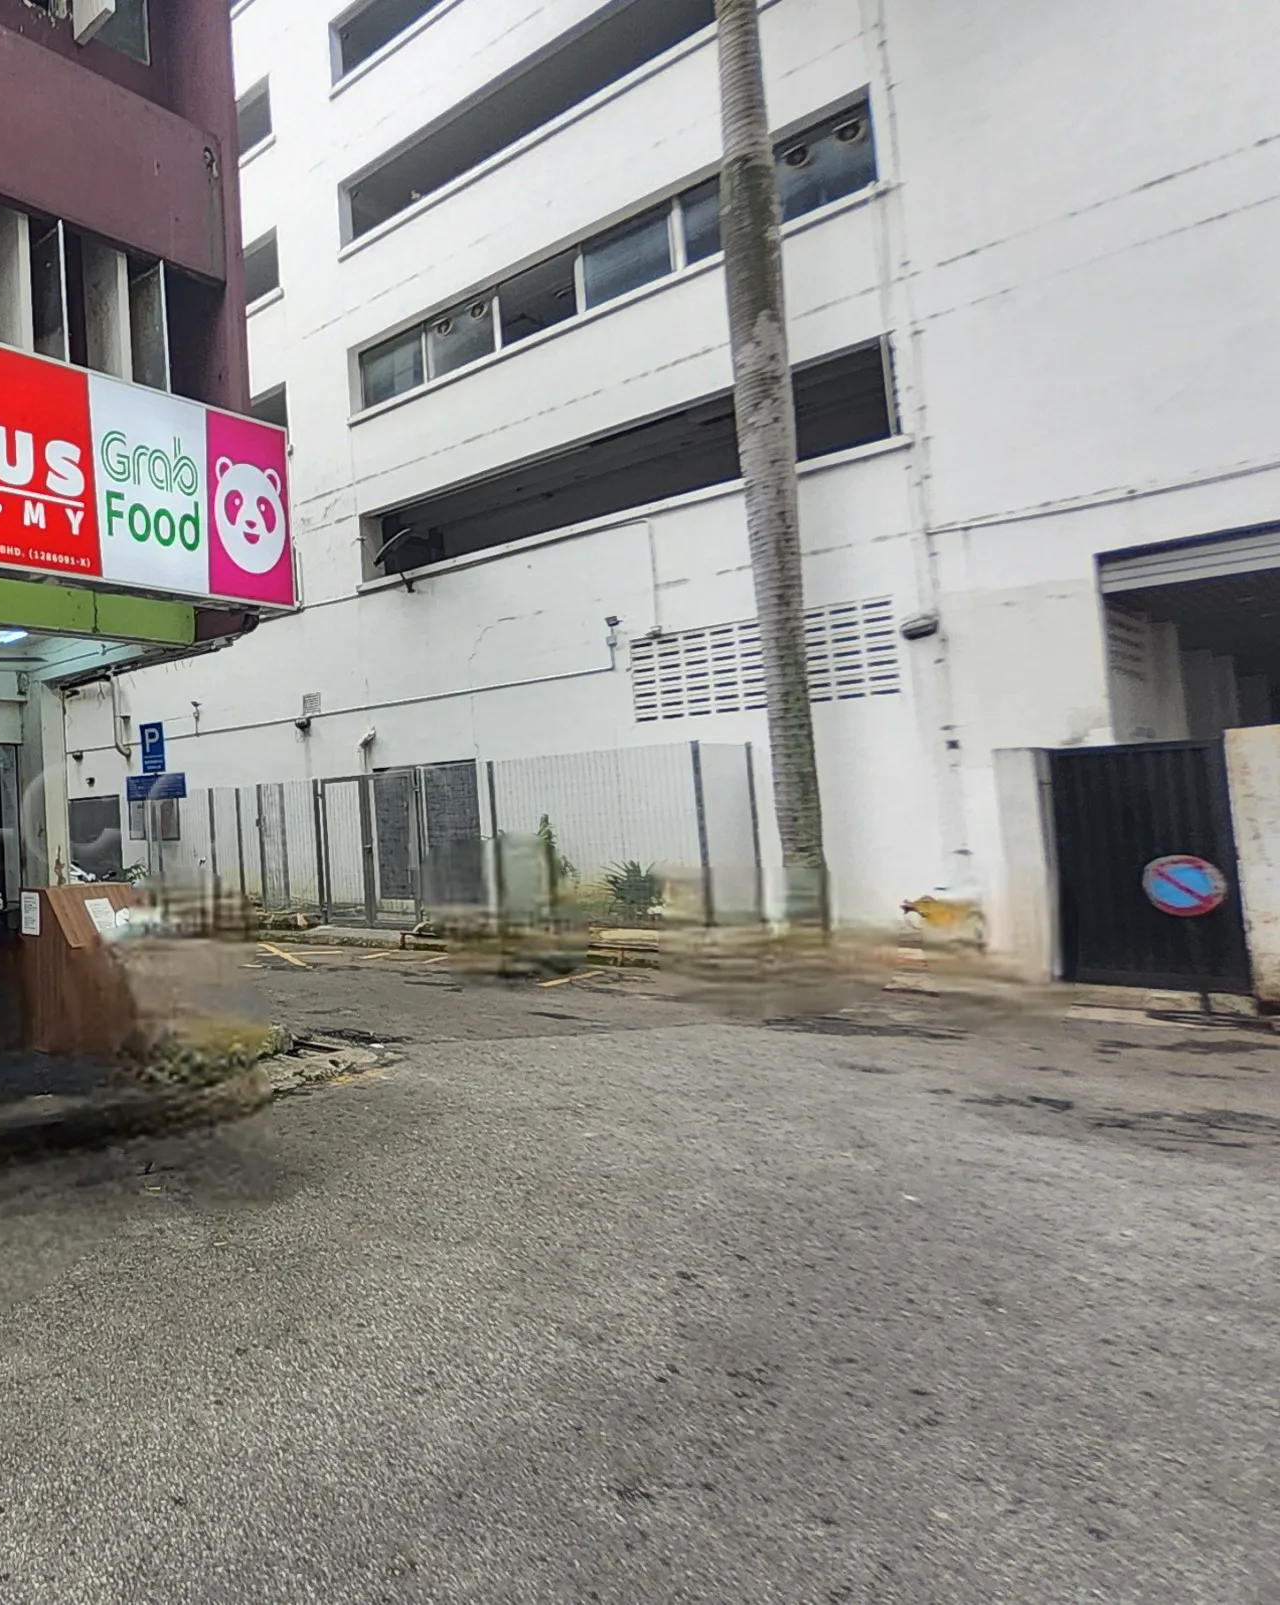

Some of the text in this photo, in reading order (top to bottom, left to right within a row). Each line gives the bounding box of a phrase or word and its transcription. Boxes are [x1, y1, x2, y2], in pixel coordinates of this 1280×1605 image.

[100, 429, 199, 497] Grab
[105, 488, 201, 552] Food
[144, 727, 160, 753] P
